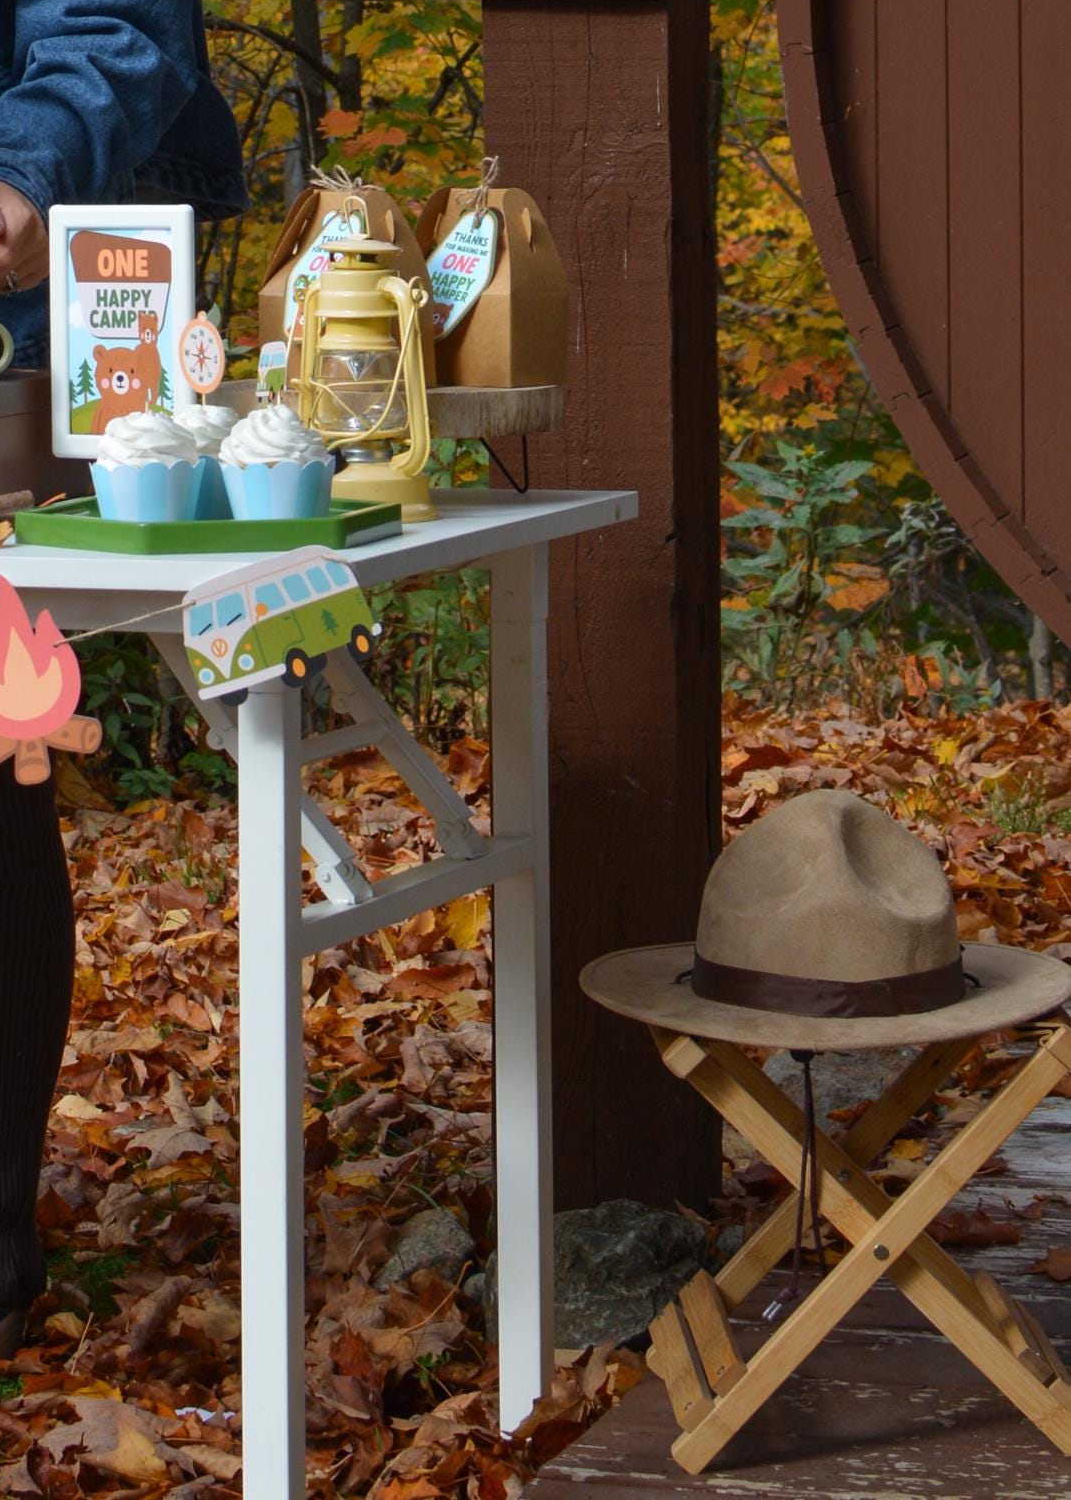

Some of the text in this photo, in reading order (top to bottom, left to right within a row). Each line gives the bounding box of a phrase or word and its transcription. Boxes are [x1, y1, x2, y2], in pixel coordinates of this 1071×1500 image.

[455, 232, 489, 247] THANKS
[457, 245, 479, 254] MAKING
[97, 249, 149, 277] ONE
[442, 253, 480, 274] ONE
[432, 271, 475, 291] HAPPY
[96, 289, 151, 307] HAPPY
[433, 287, 468, 302] AMPER
[90, 310, 157, 328] CAMP
